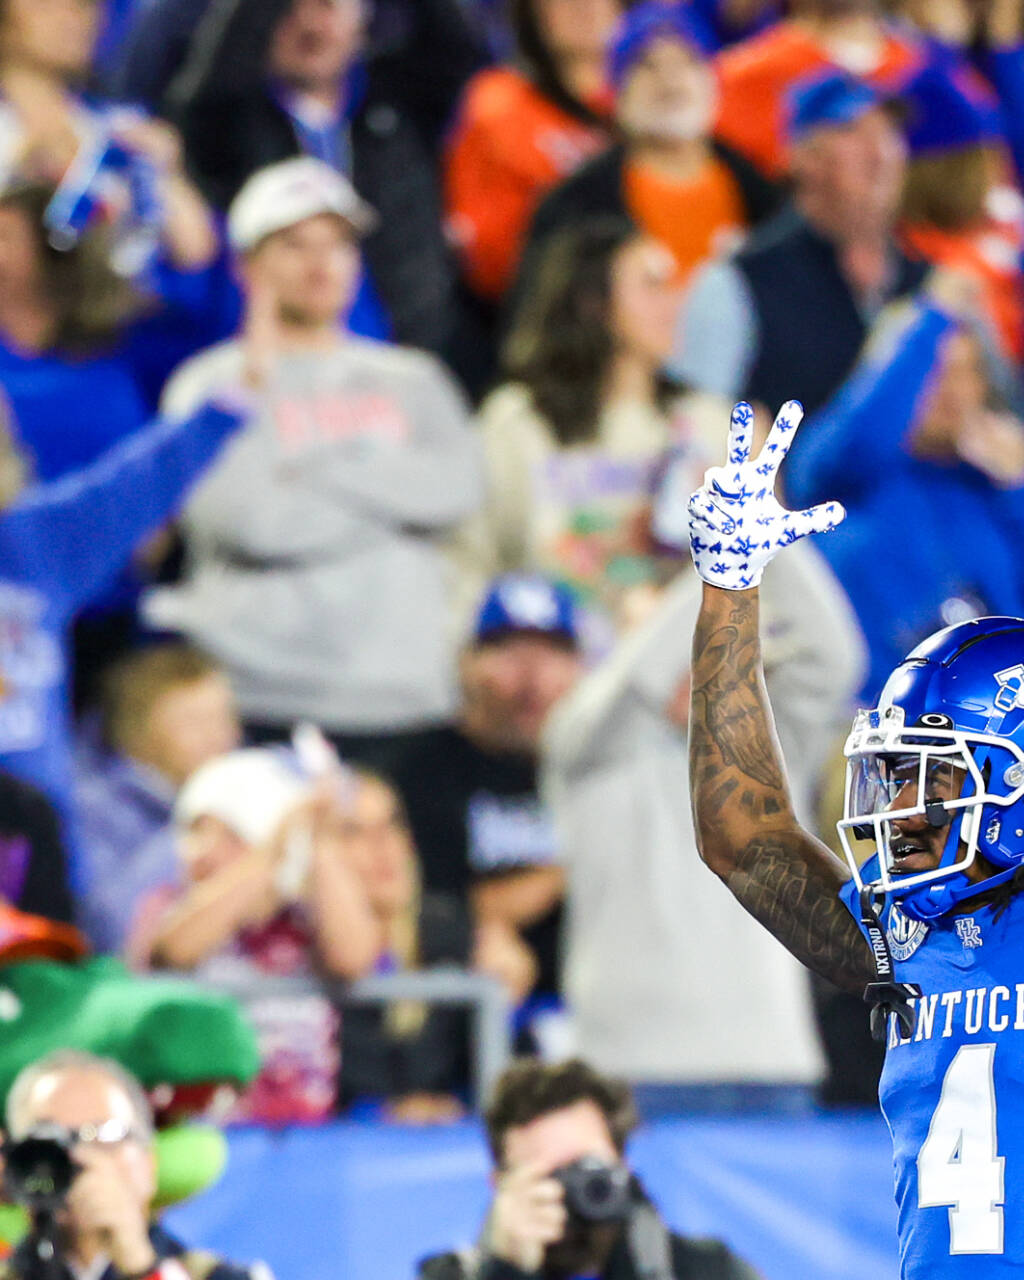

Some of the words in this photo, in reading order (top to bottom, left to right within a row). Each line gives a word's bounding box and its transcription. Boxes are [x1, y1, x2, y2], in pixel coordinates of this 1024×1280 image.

[868, 927, 891, 975] NXTRND
[954, 917, 984, 949] UK
[916, 1042, 1006, 1256] 4
